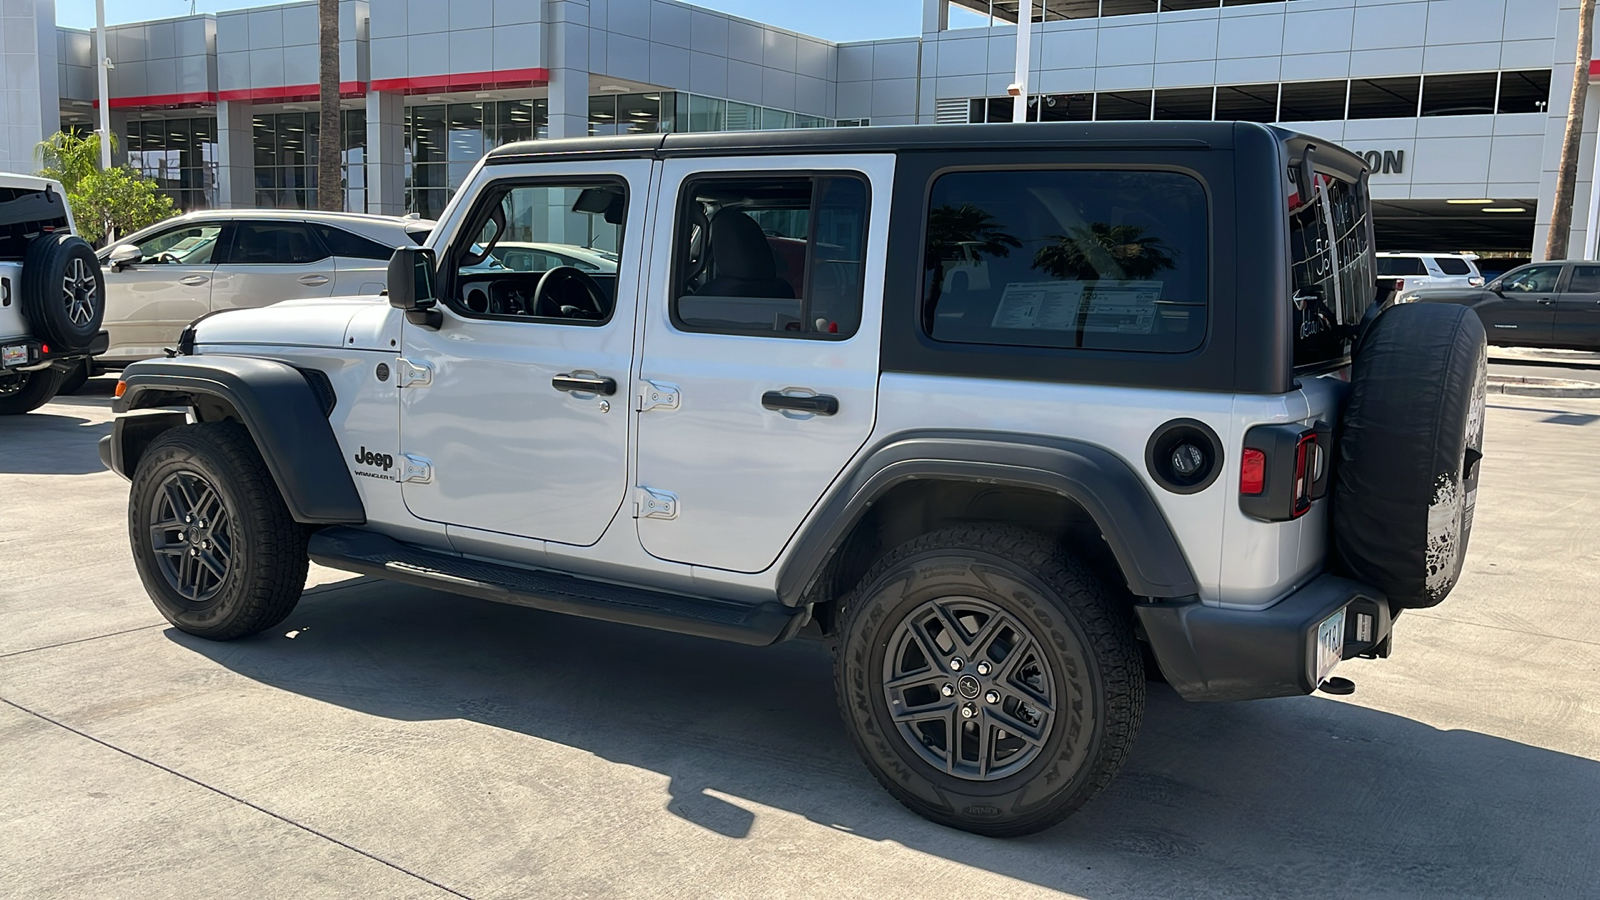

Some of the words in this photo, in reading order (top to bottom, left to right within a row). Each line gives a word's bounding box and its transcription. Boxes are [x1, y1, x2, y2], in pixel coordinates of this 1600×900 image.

[1356, 150, 1404, 174] ON
[354, 446, 393, 472] Jeep
[354, 470, 389, 480] WRANGLER
[848, 599, 912, 784] WRANGLER
[1011, 590, 1084, 787] GOODYEAR
